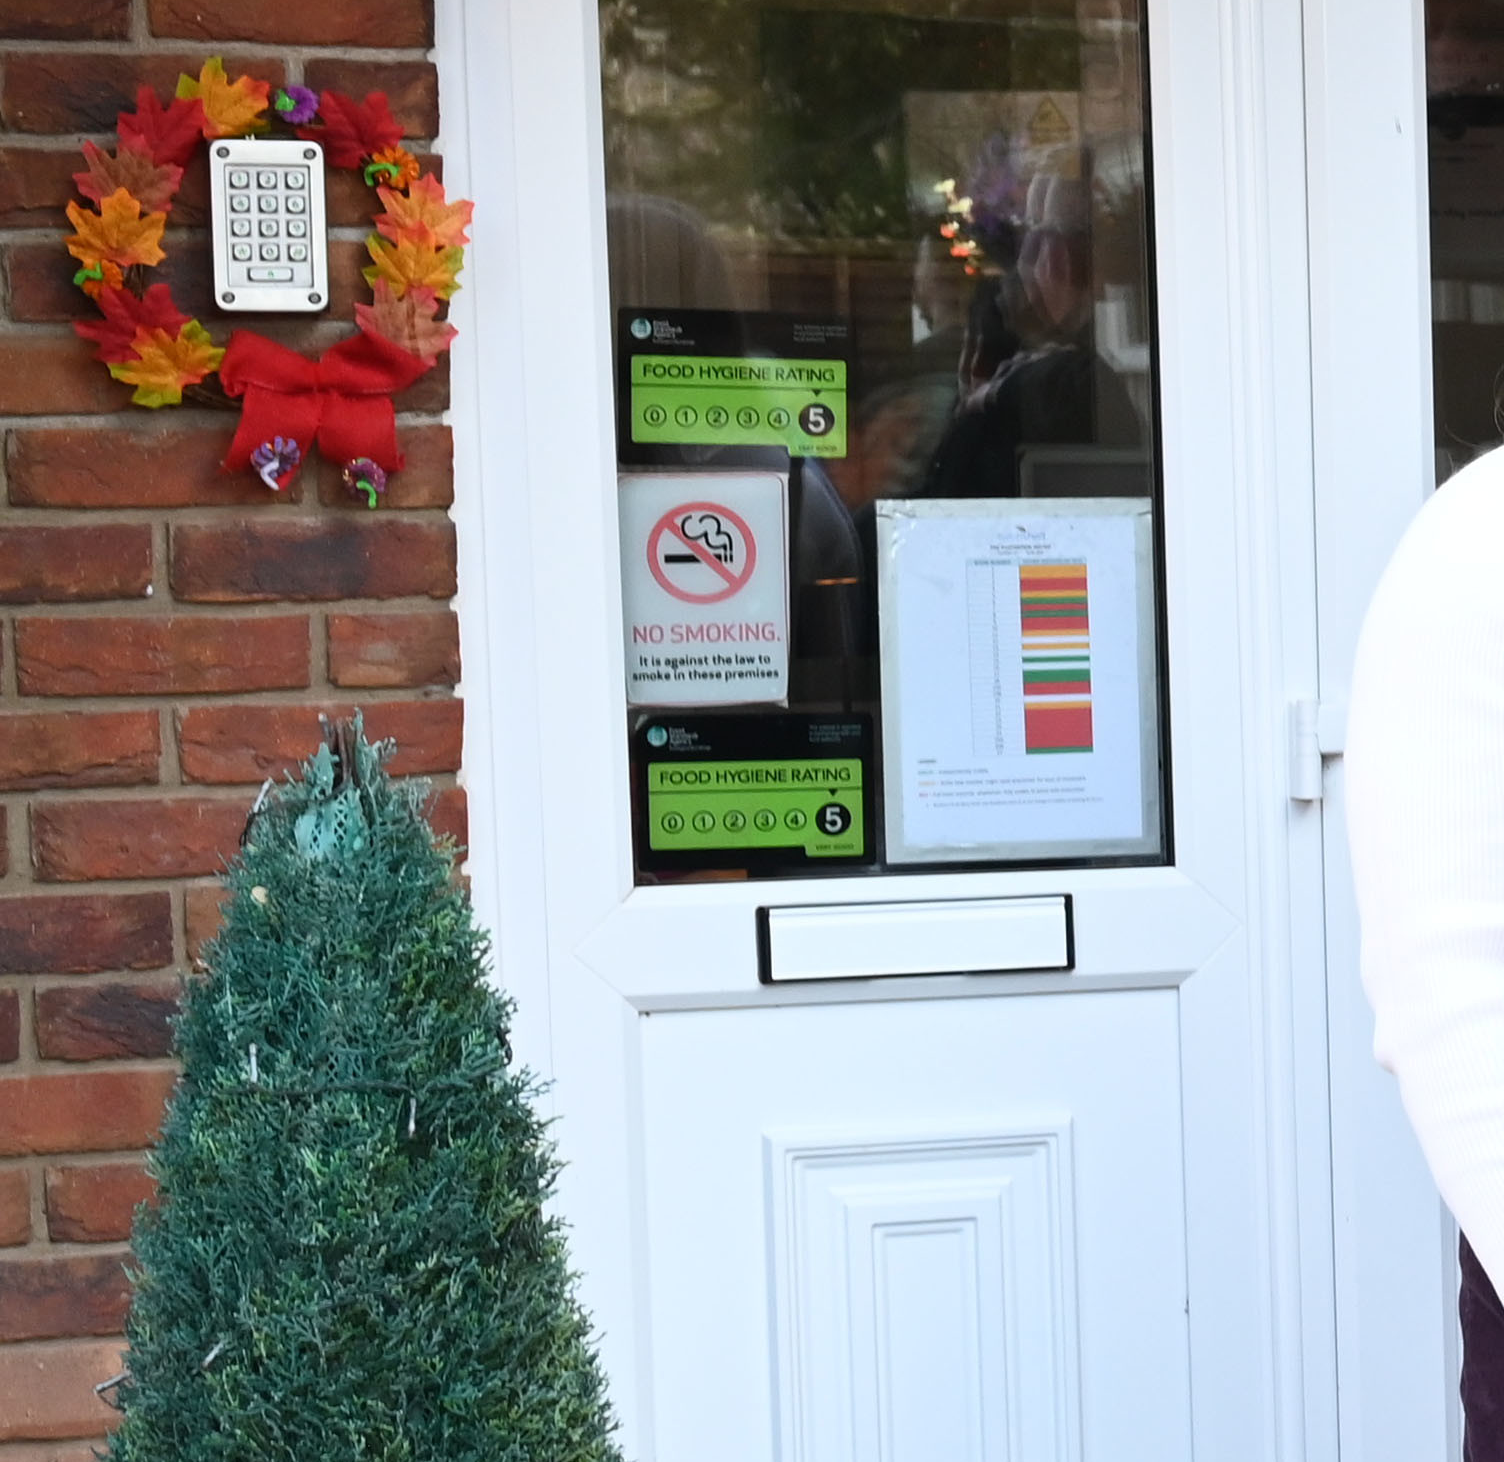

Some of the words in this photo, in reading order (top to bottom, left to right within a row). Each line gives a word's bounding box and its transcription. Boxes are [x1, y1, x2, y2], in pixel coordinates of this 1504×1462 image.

[642, 363, 695, 379] FOOD
[699, 365, 771, 381] HYGIENE
[775, 368, 835, 383] RATING
[807, 407, 827, 434] 5
[632, 625, 664, 644] NO
[670, 622, 781, 644] SMOKING.
[639, 655, 648, 667] It
[651, 655, 662, 667] is
[664, 654, 710, 669] against
[712, 653, 732, 666] the
[735, 653, 756, 665] law
[758, 653, 771, 665] to
[632, 669, 671, 682] smoke
[673, 668, 685, 681] in
[688, 668, 722, 681] these
[725, 667, 780, 683] premises
[659, 769, 711, 786] FOOD
[715, 768, 788, 784] HYGIENE
[790, 767, 852, 783] RATING
[824, 806, 843, 833] 5
